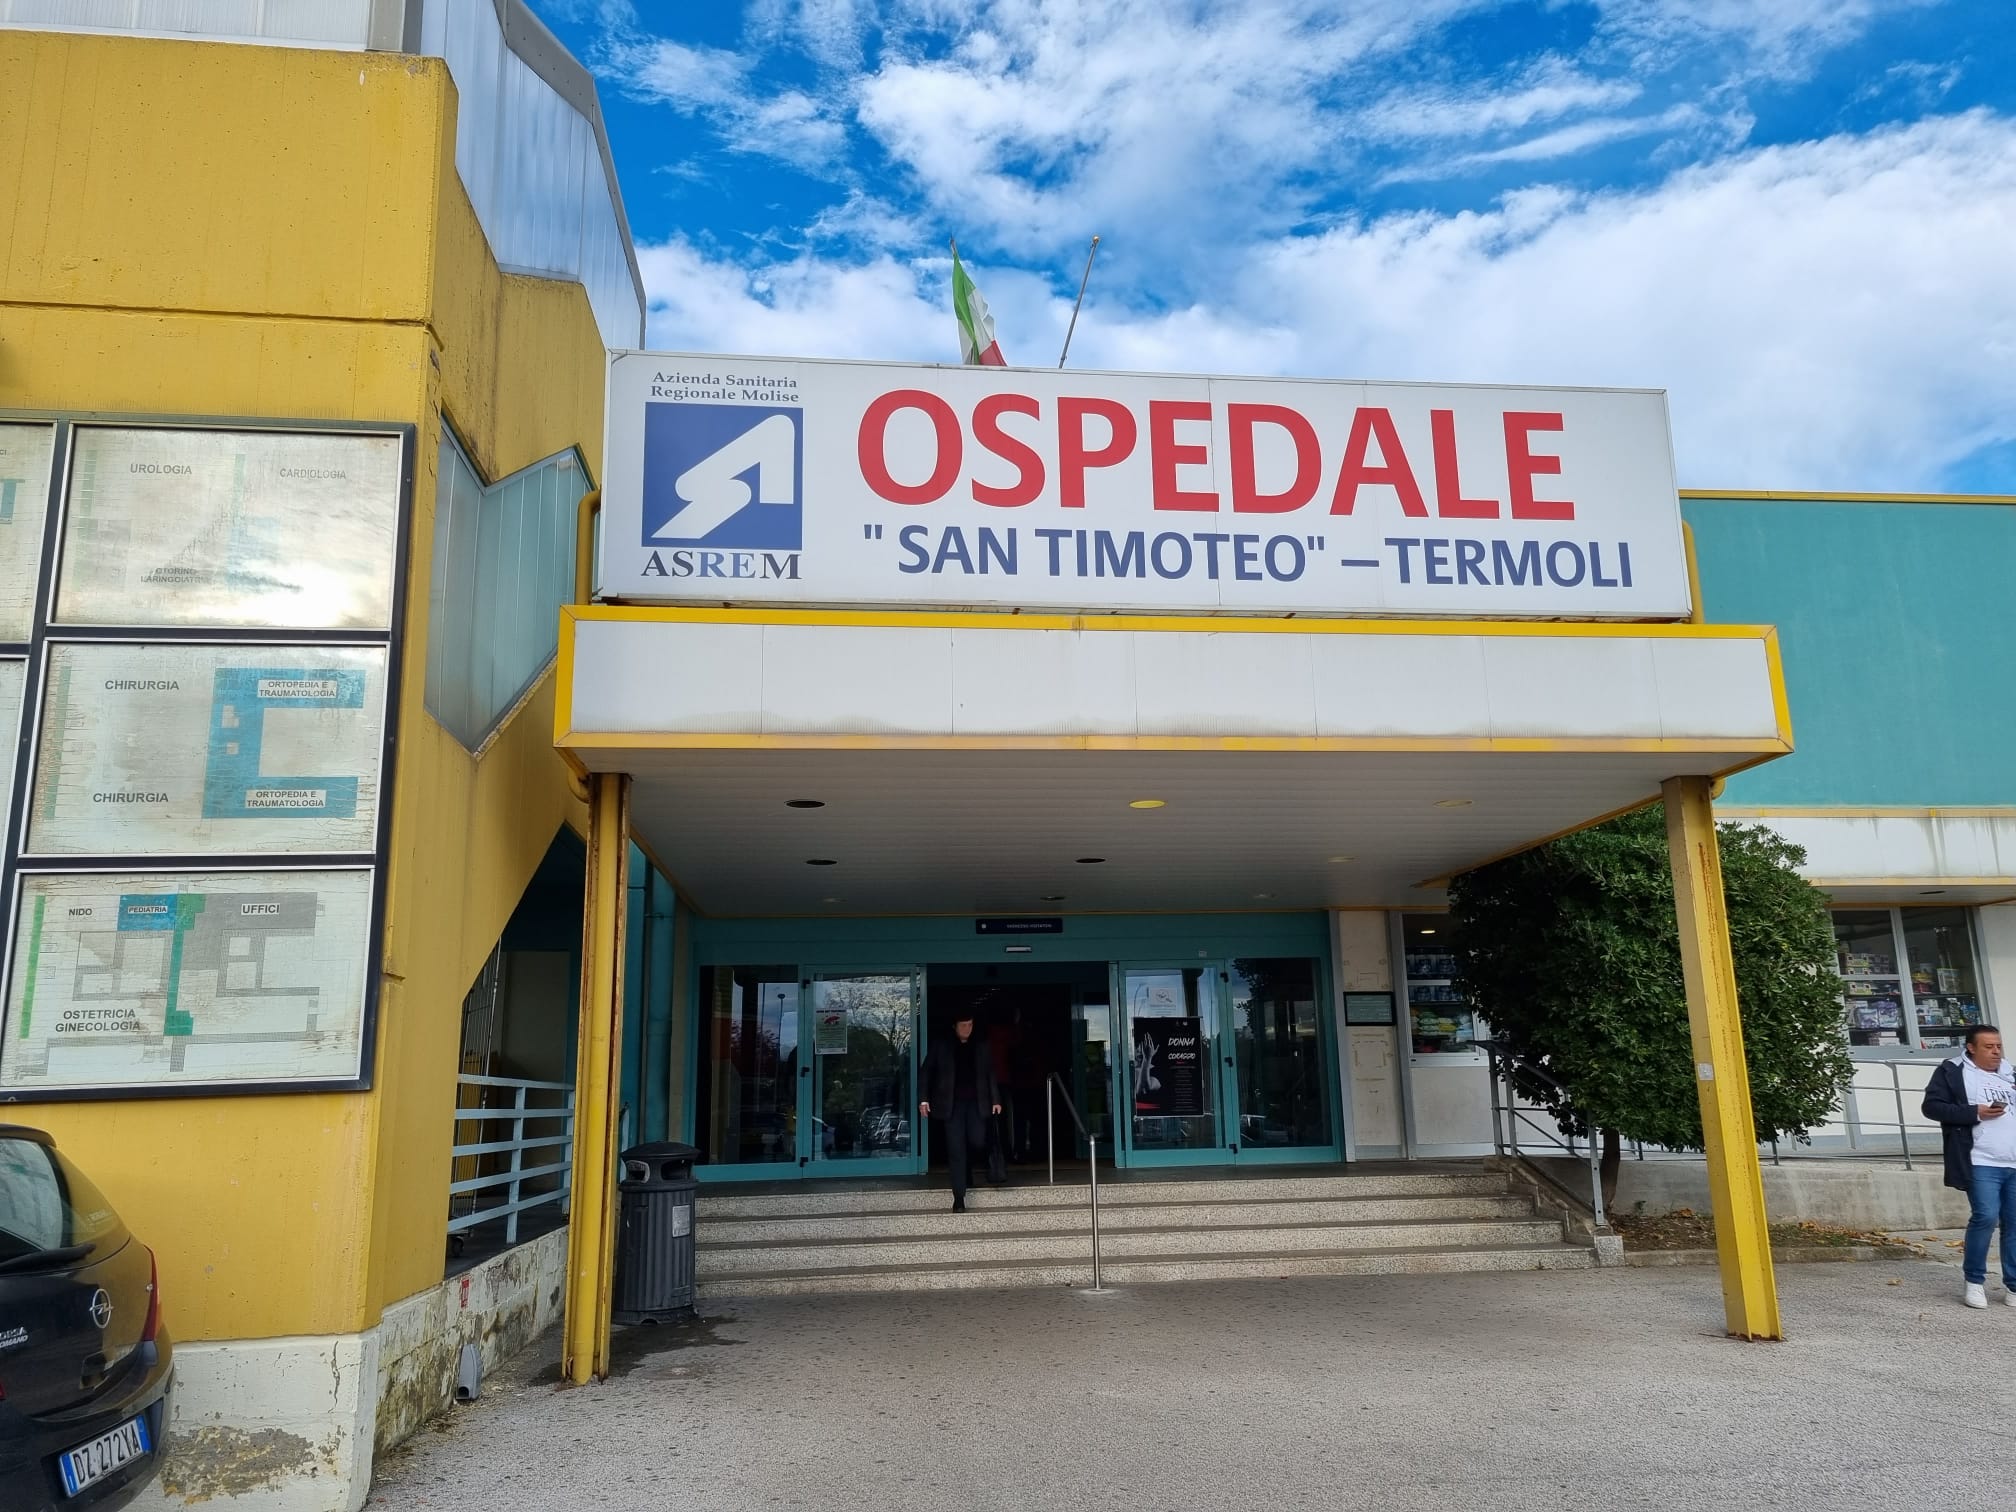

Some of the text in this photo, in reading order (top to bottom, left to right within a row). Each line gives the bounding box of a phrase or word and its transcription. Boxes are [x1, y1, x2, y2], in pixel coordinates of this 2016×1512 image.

[652, 371, 798, 389] Azienda Sanitaria
[651, 385, 800, 403] Regionale Molise
[857, 388, 1575, 521] OSPEDALE
[130, 463, 192, 475] UROLOGIA
[279, 467, 347, 480] CARDIOLOGIA
[1035, 527, 1325, 583] TIMOTEO"
[1385, 536, 1634, 588] TERMOLI
[641, 549, 803, 581] ASREM
[104, 679, 180, 691] CHIRURGIA
[268, 680, 329, 689] ORTOPEDIA E
[259, 689, 336, 698] TRAUMATOLOGIA
[93, 792, 169, 803] CHIRURGIA
[255, 790, 316, 799] ORTOPEDIA E
[246, 798, 325, 808] TRAUMATOLOGIA
[68, 907, 93, 916] NIDO
[127, 905, 168, 913] PEDIATRIA
[241, 903, 281, 915] UFFICI
[63, 1009, 136, 1020] OSTETRICIA
[55, 1020, 142, 1033] GINECOLOGIA
[1168, 1037, 1195, 1047] DONNA
